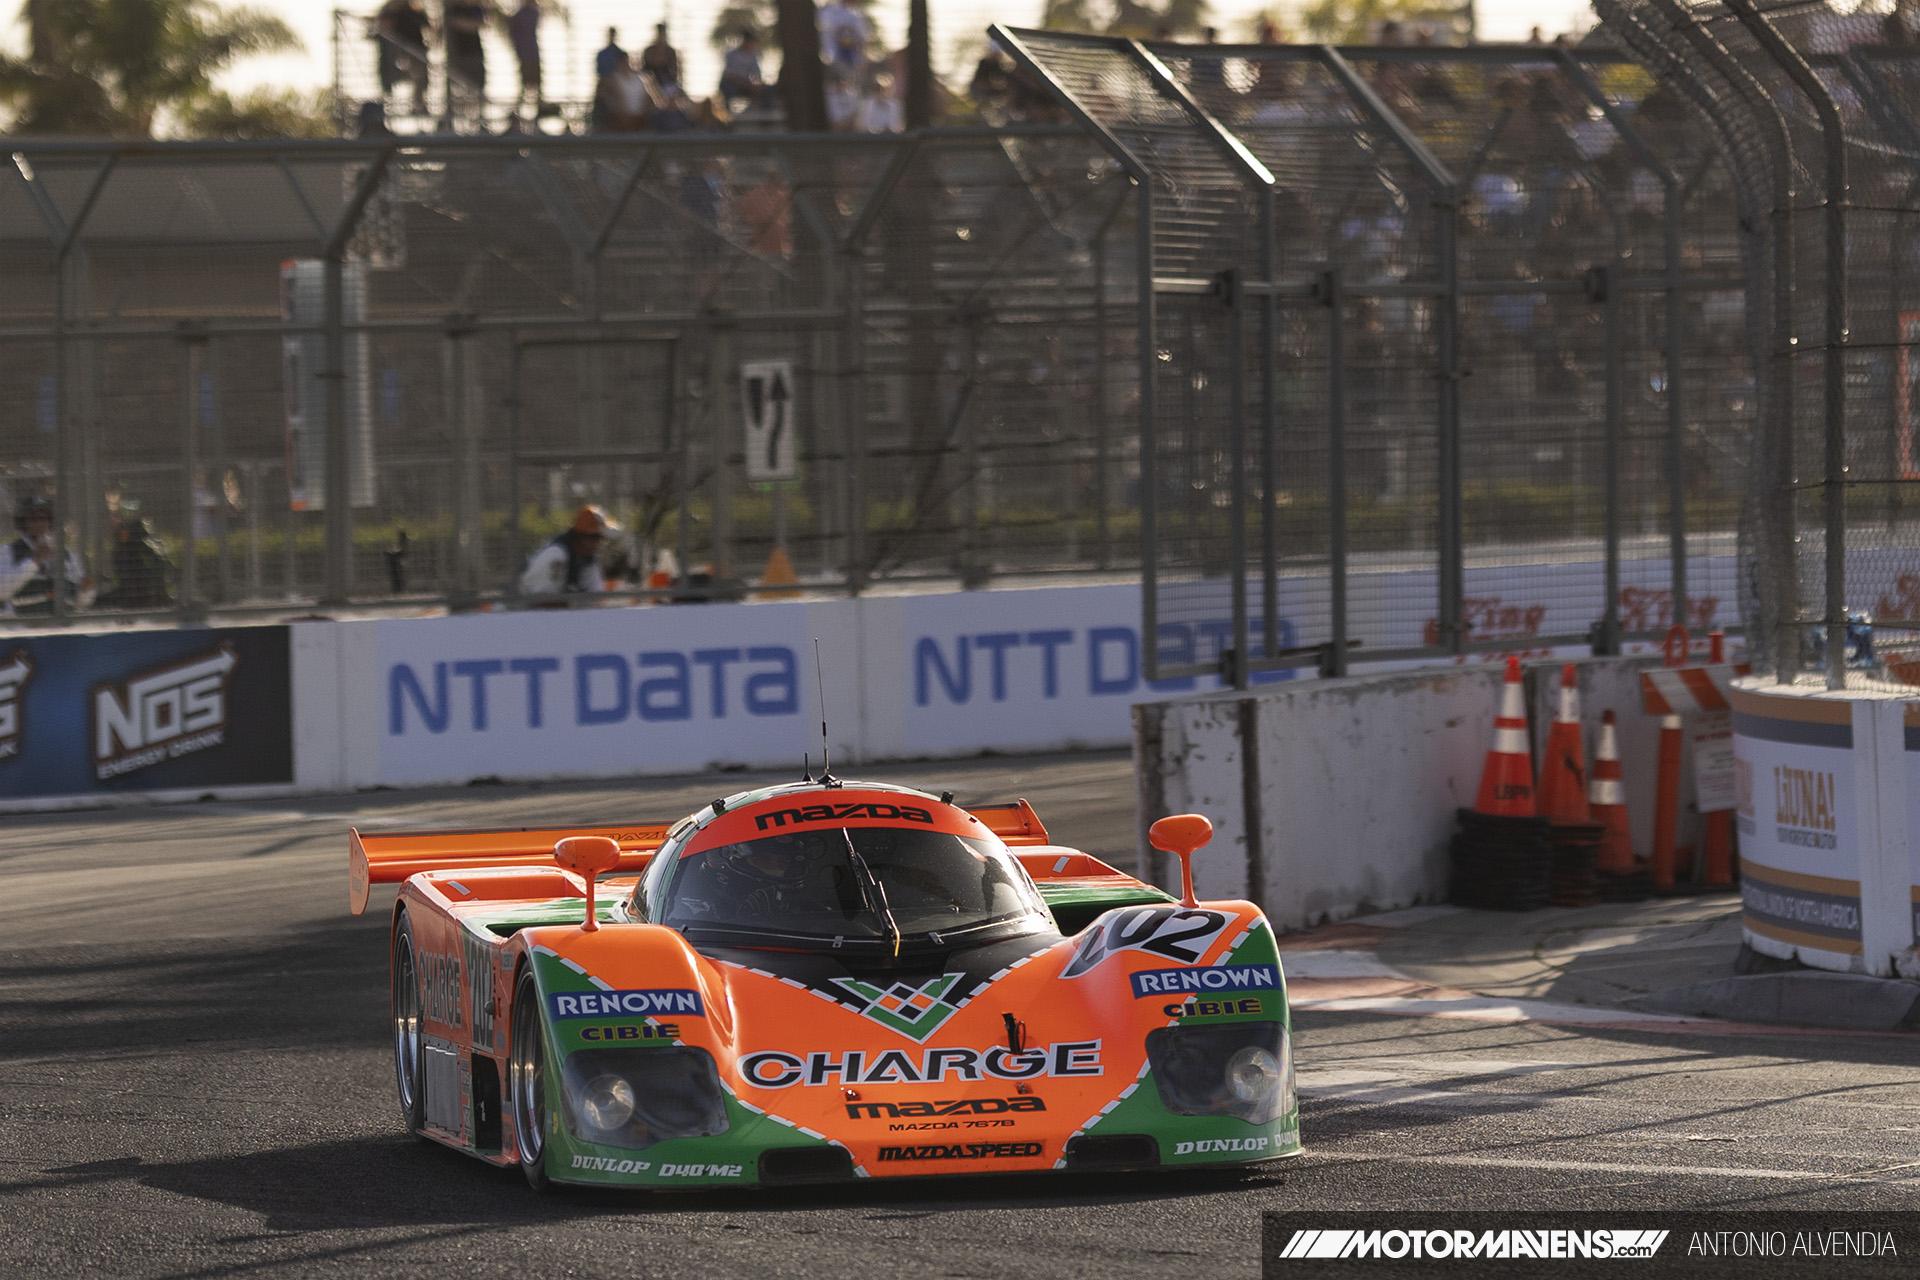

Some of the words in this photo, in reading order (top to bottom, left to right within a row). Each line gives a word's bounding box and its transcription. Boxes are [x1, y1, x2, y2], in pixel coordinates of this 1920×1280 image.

[914, 628, 1075, 707] NTT
[96, 650, 236, 759] NOS
[388, 658, 560, 735] NTT
[98, 748, 167, 780] ENERGY
[418, 944, 463, 1029] CHARGE
[1139, 968, 1272, 993] RENOWN
[557, 993, 697, 1015] RENOWN
[739, 1039, 1104, 1089] CHARGE
[889, 1122, 960, 1132] MAZDA
[962, 1119, 1016, 1129] 767B
[878, 1143, 1043, 1162] MAZDASPEED
[1173, 1137, 1268, 1156] DUNLOP
[571, 1155, 651, 1174] DUNLOP
